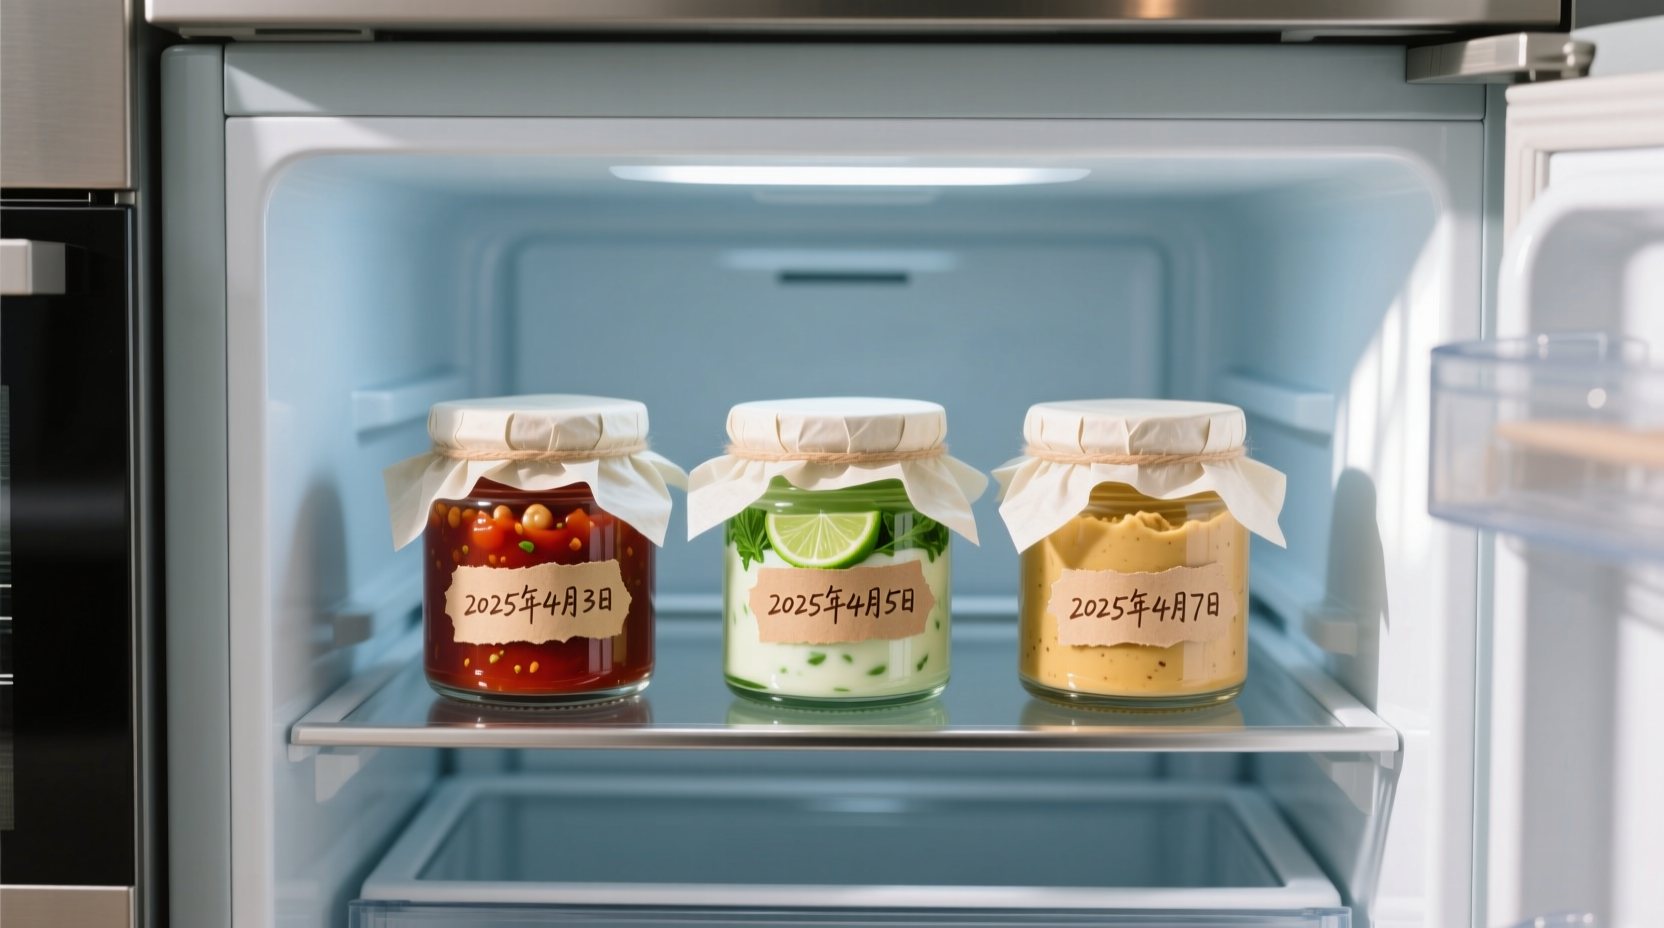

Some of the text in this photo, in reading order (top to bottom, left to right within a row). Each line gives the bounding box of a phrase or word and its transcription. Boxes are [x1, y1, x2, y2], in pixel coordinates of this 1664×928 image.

[463, 584, 613, 625] 2025年4月3日
[767, 584, 915, 625] 2025年4月5日
[1069, 588, 1220, 629] 2025年4月7日
